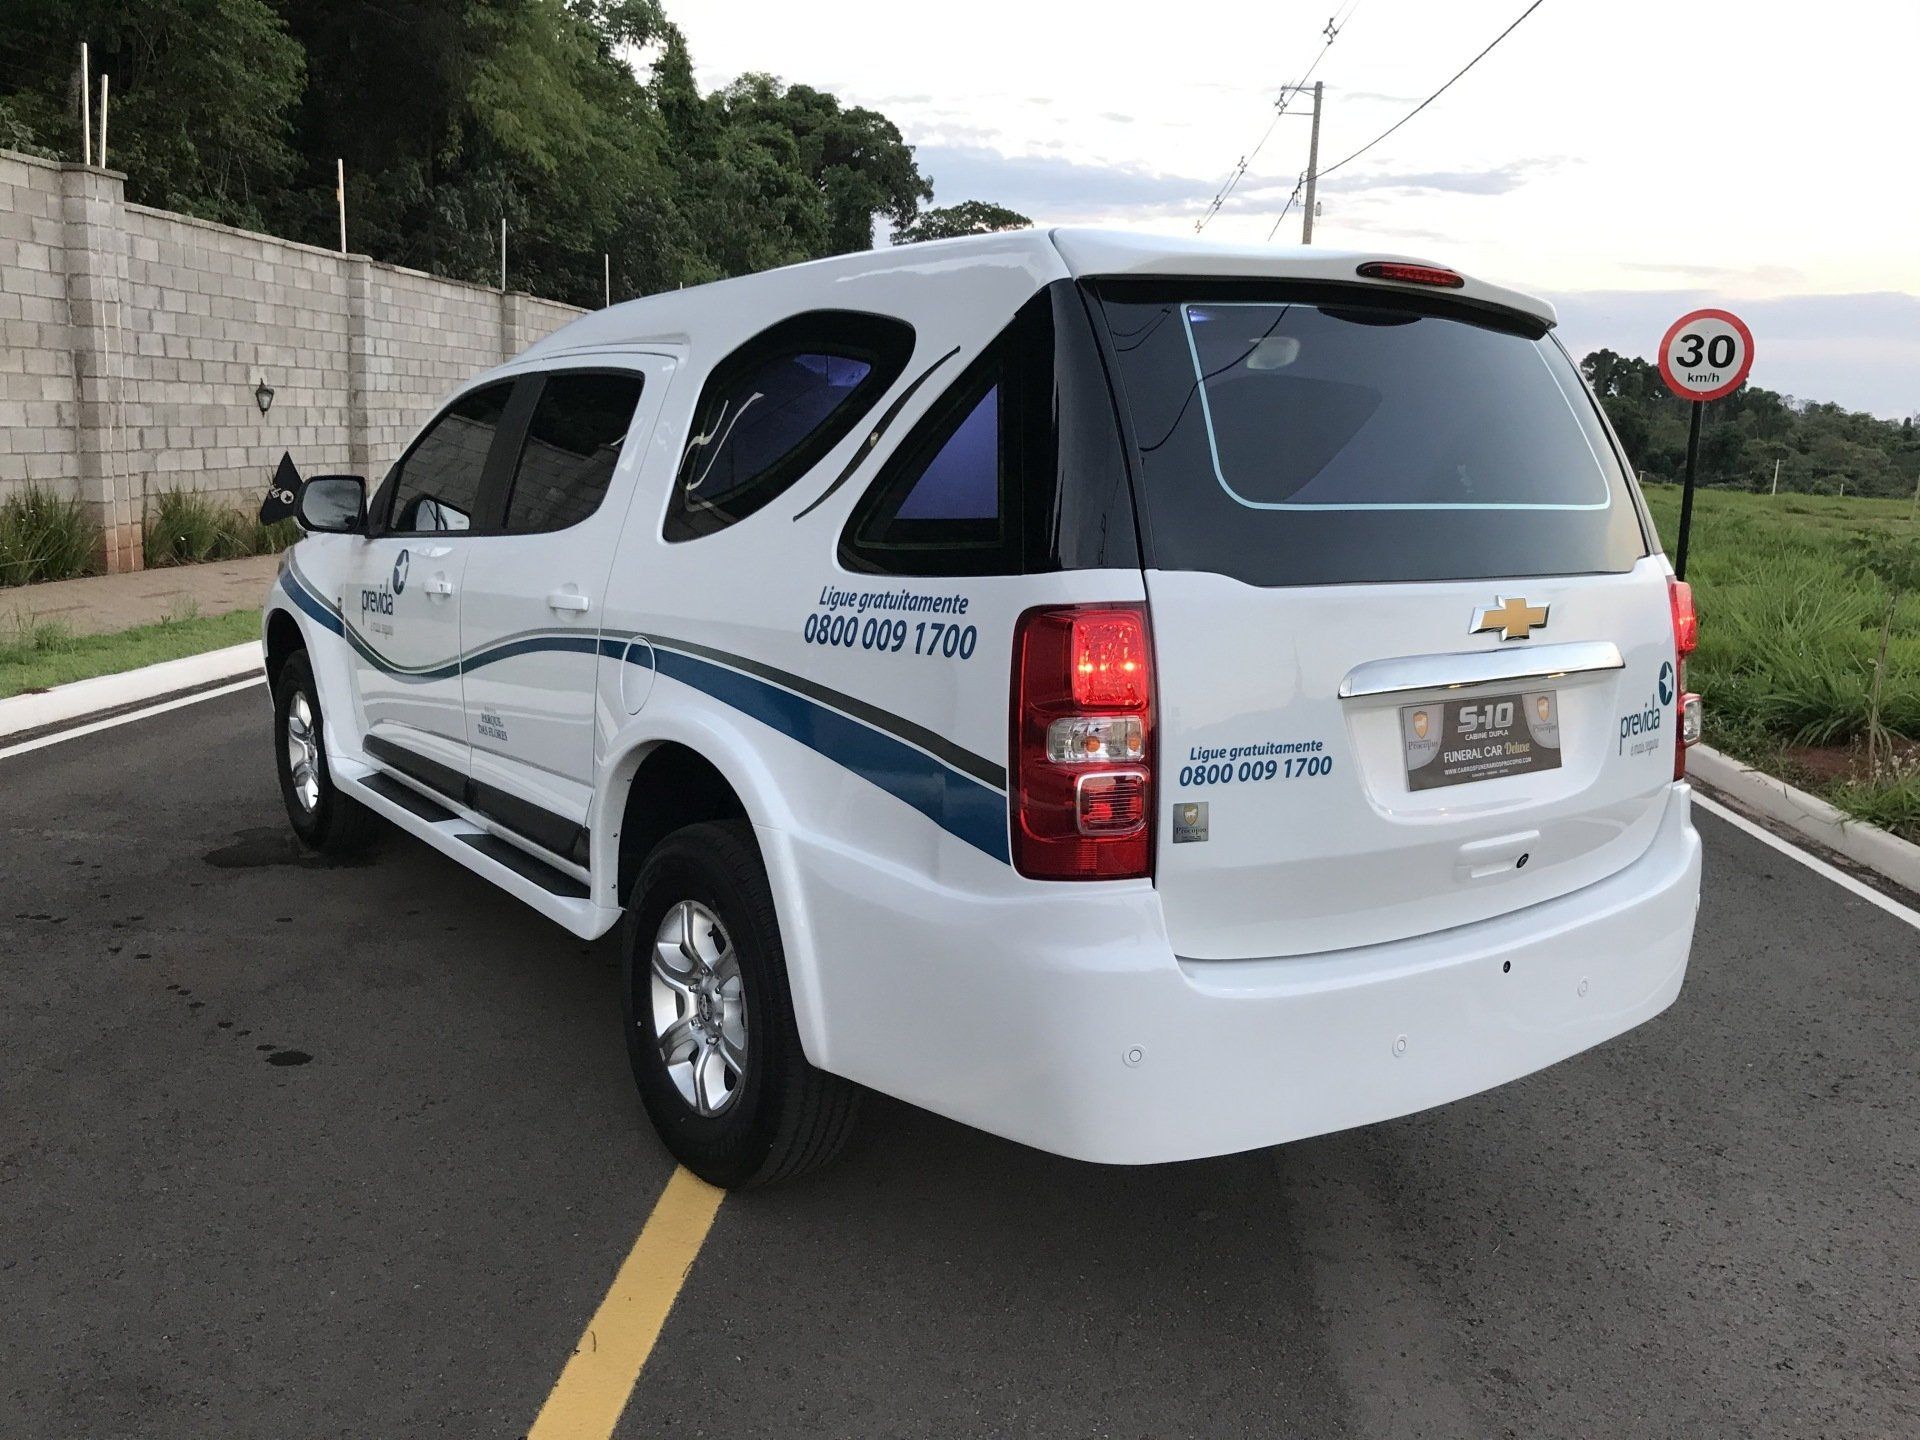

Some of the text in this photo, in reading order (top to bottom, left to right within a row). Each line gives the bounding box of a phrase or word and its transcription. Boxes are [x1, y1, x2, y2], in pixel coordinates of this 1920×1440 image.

[1676, 334, 1736, 368] 30
[1687, 372, 1720, 382] km/h
[361, 577, 394, 625] previda
[819, 585, 969, 614] Ligue gratuitamente
[804, 613, 977, 660] 0800 009 1700
[1457, 701, 1514, 733] S-10
[1619, 693, 1660, 756] previda
[1465, 729, 1509, 741] CABINE DUPLA
[1190, 740, 1323, 763] Ligue gratuitamente
[1443, 741, 1530, 763] FUNERAL CAR Deluxe
[1179, 755, 1333, 787] 0800 009 1700
